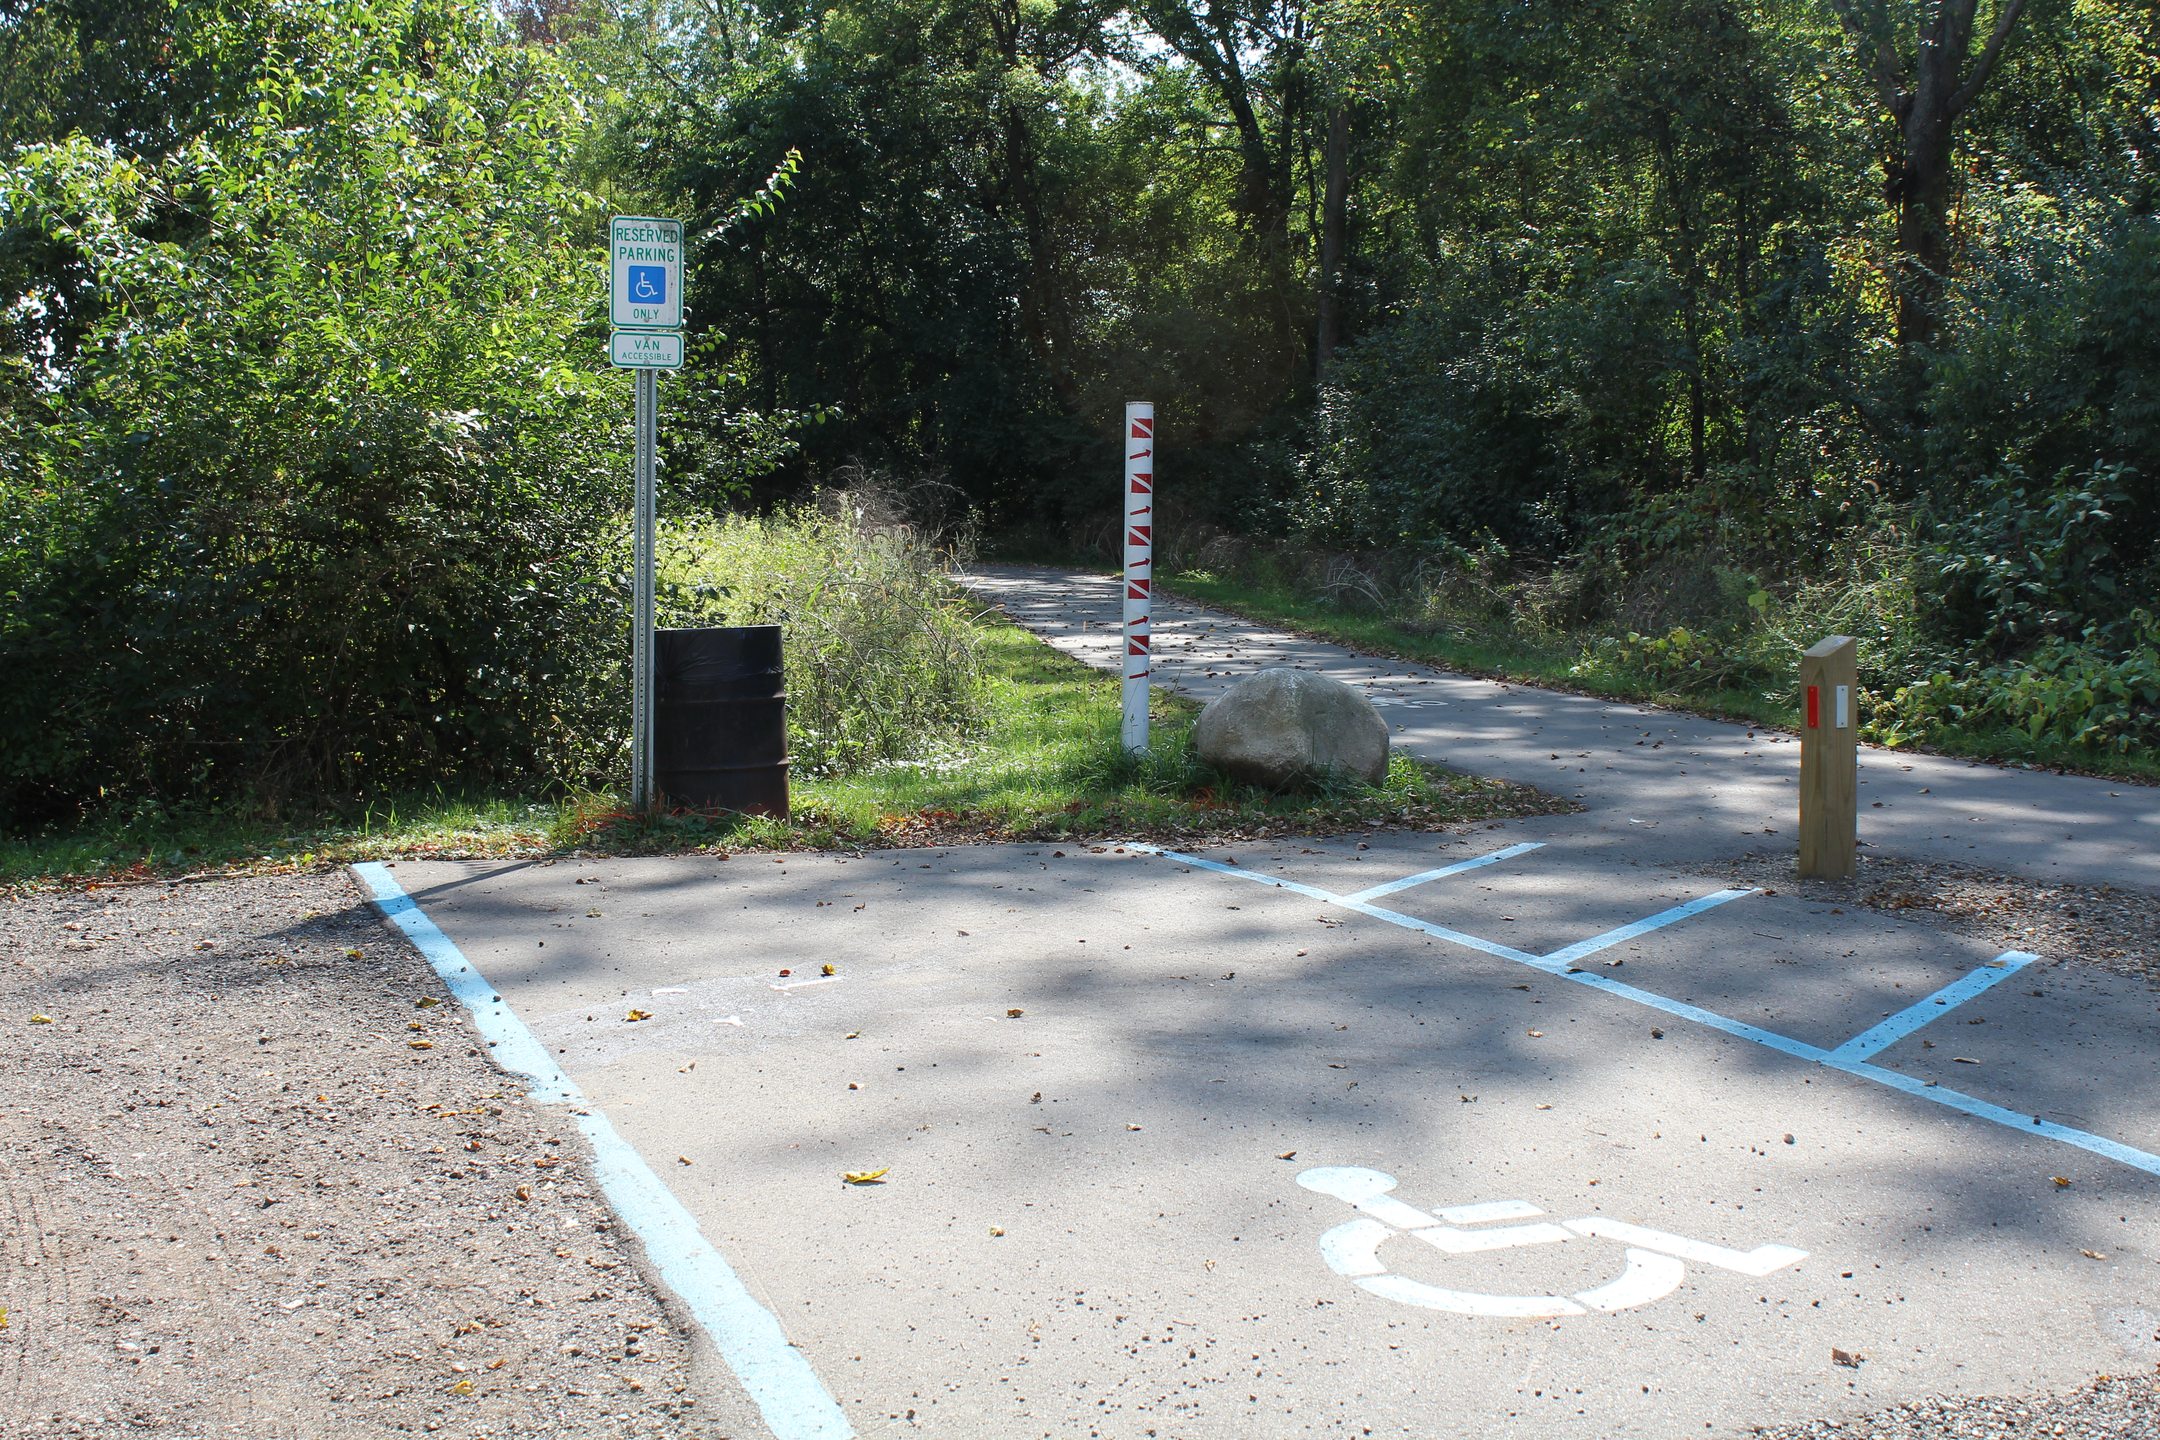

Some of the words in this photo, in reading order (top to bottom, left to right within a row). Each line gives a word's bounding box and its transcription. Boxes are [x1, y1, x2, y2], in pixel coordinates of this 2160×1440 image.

[616, 227, 678, 243] RESERVED
[619, 246, 675, 262] PARKING
[633, 308, 659, 320] ONLY
[634, 340, 660, 350] VAN
[621, 352, 672, 361] ACCESSIBLE
